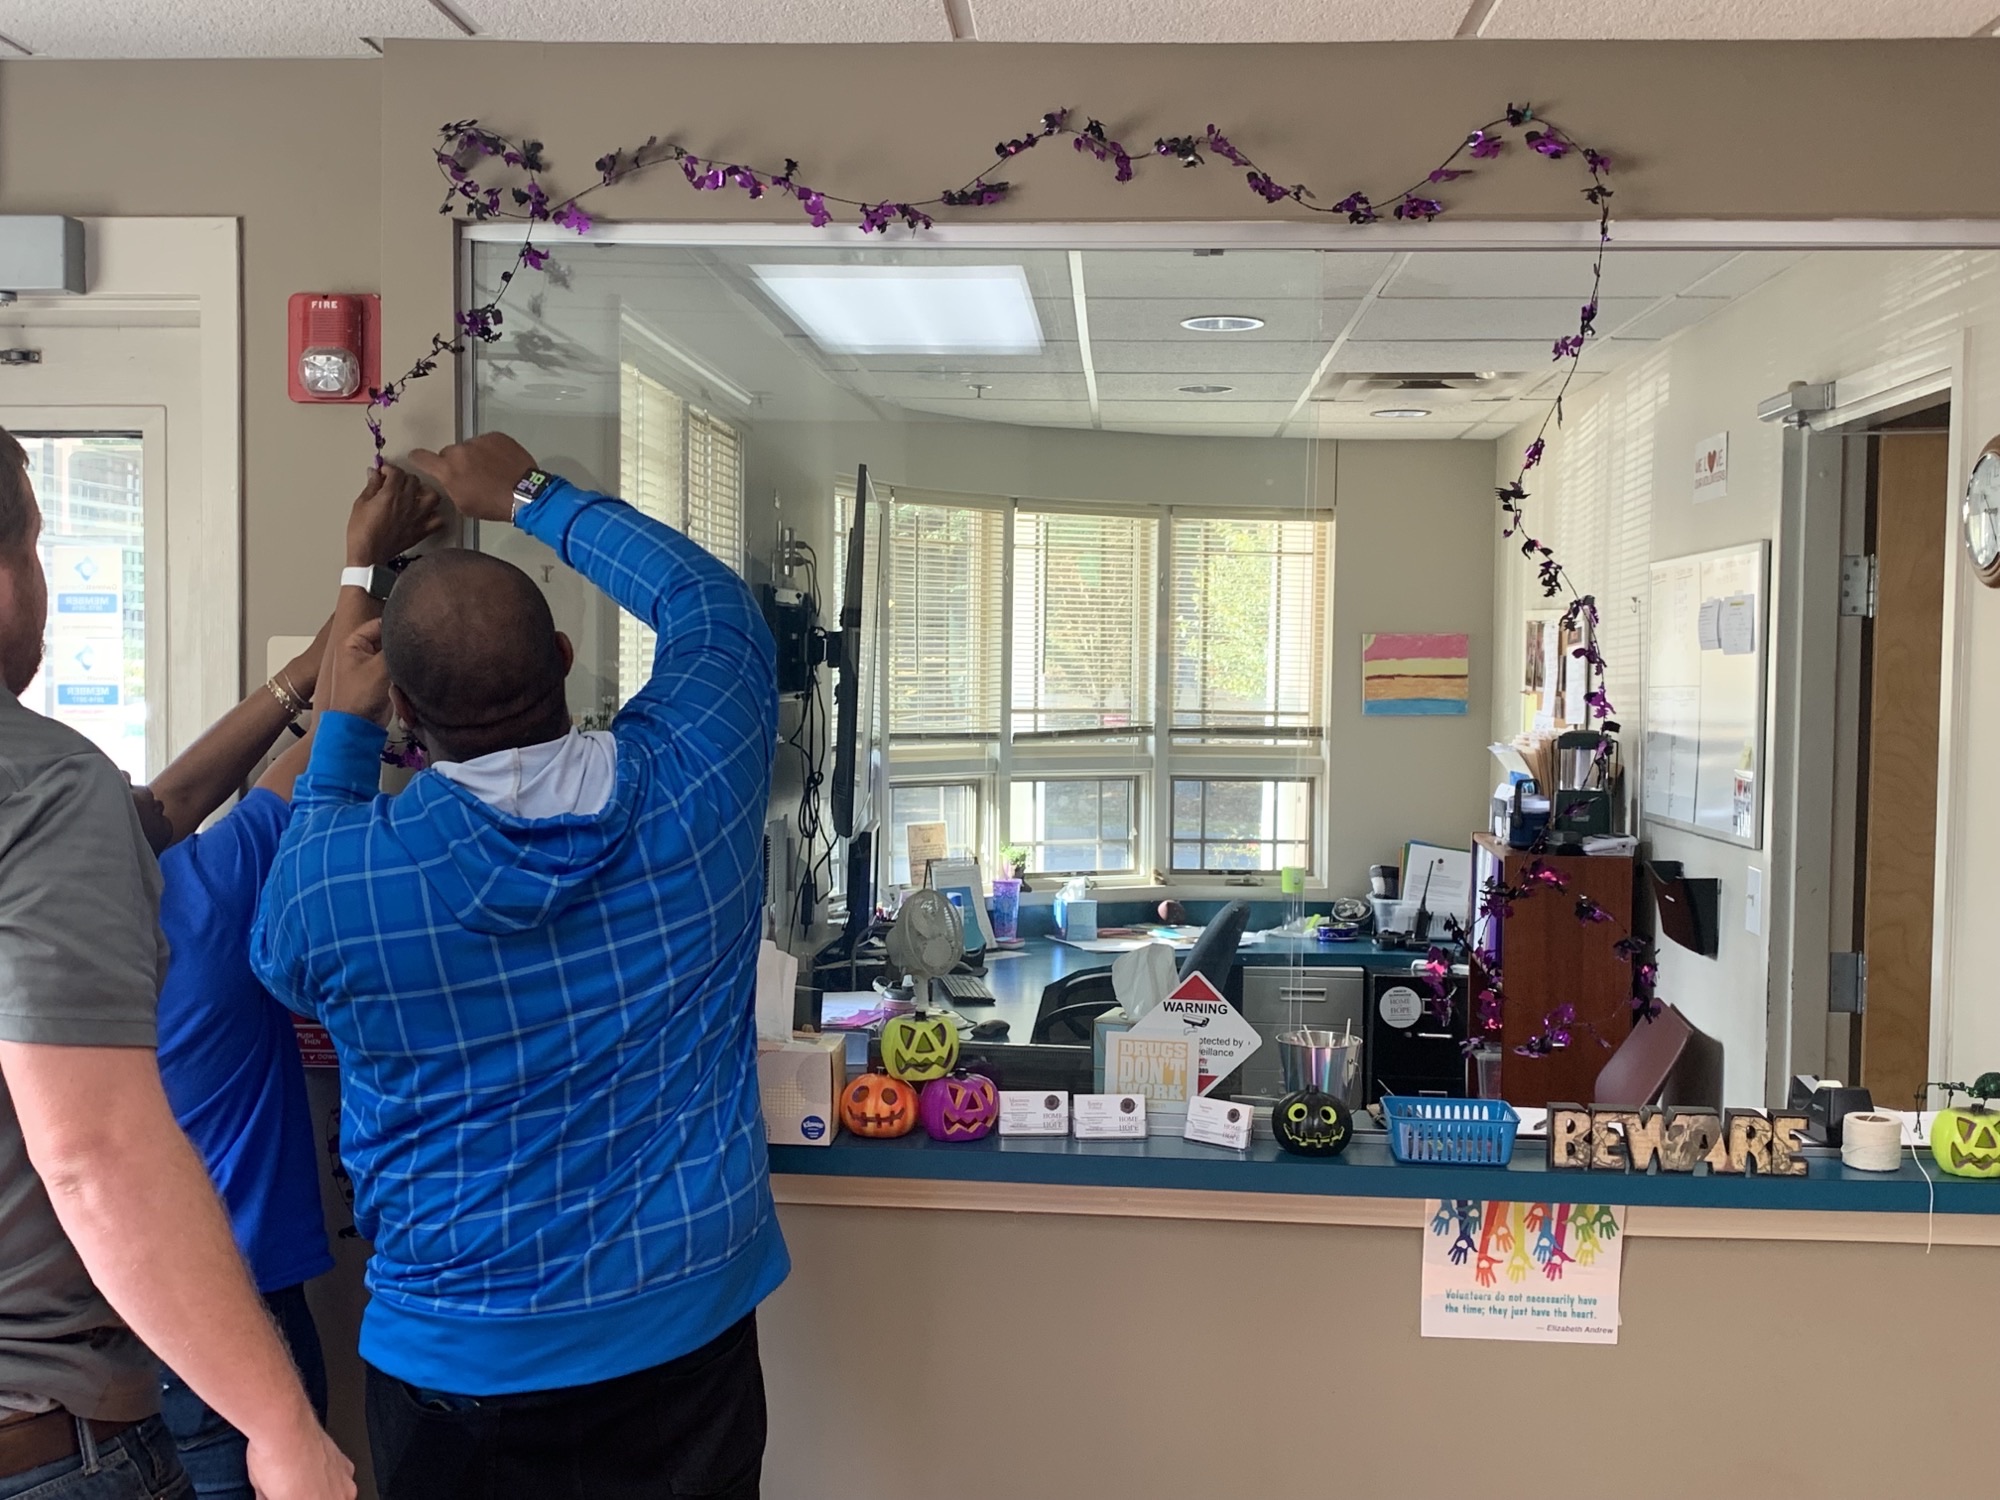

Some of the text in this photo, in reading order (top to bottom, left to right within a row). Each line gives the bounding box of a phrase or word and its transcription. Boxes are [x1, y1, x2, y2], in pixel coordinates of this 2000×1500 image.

[311, 300, 338, 309] FIRE
[529, 471, 545, 485] 10
[517, 479, 539, 493] 24
[1163, 1001, 1228, 1015] WARNING
[296, 1032, 314, 1040] PUSH
[1199, 1037, 1244, 1049] otected by
[1120, 1040, 1186, 1057] DRUGS
[1199, 1047, 1235, 1058] eillance
[1119, 1055, 1186, 1085] DON'T
[1118, 1082, 1183, 1101] WORK
[1547, 1101, 1809, 1177] BEWARE
[1445, 1289, 1598, 1307] Volunteers do not necessarily have
[1444, 1303, 1598, 1319] the time; they just have the heart.
[1546, 1324, 1583, 1334] Elizabeth
[1584, 1325, 1614, 1334] Andrew
